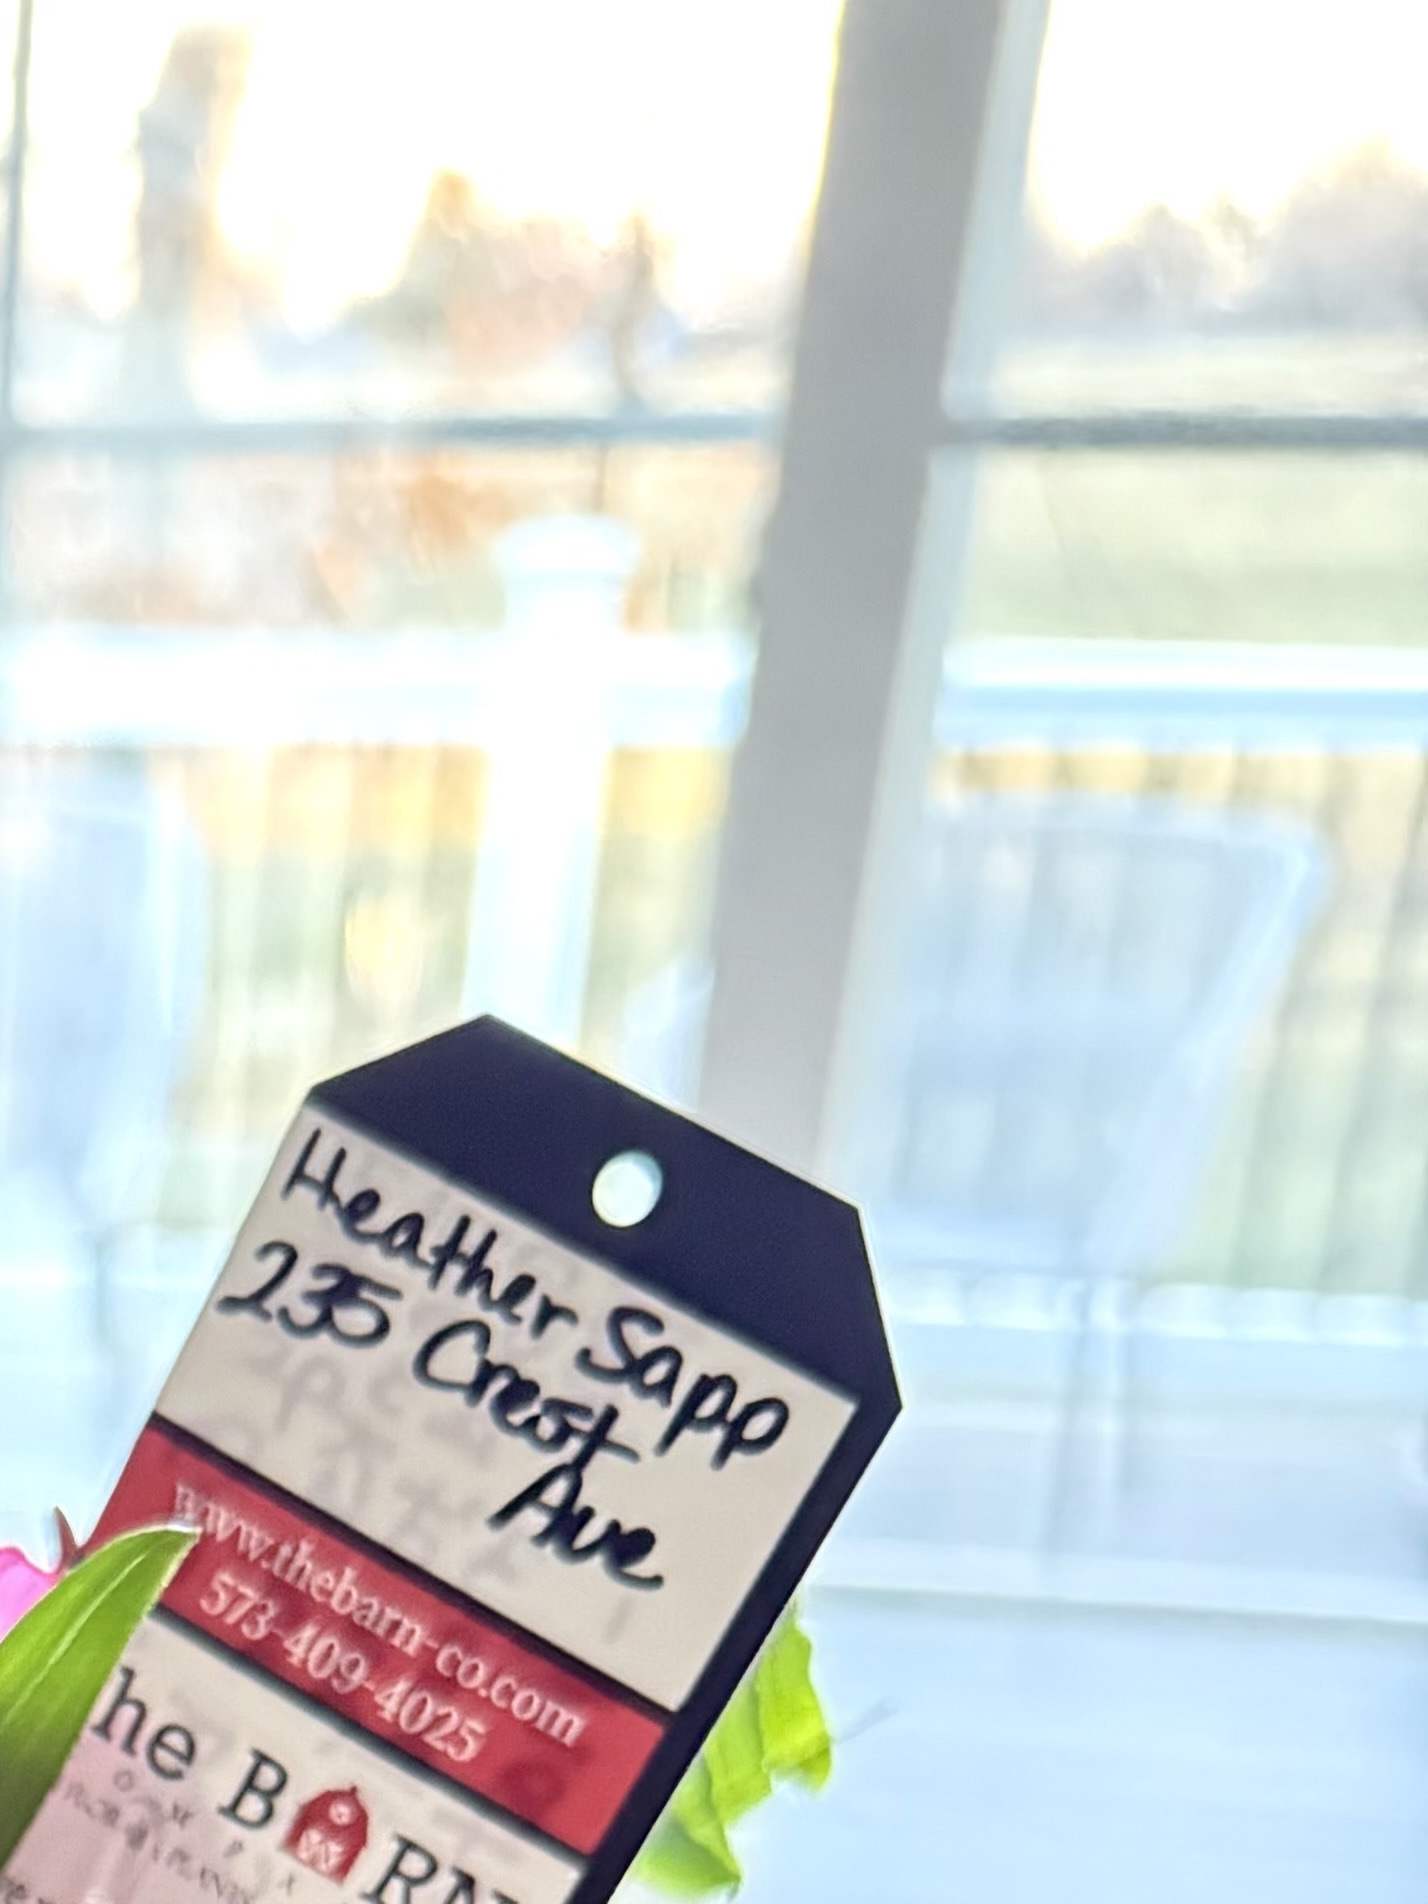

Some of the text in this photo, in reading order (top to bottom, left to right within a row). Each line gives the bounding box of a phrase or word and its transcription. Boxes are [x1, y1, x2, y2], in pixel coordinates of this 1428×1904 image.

[217, 1240, 641, 1465] 235 Crest
[282, 1127, 790, 1470] Heather Sapp
[167, 1479, 588, 1748] www.thebarn-co.com
[486, 1459, 665, 1590] Ave
[90, 1666, 198, 1782] he
[196, 1570, 493, 1768] 573-409-4025
